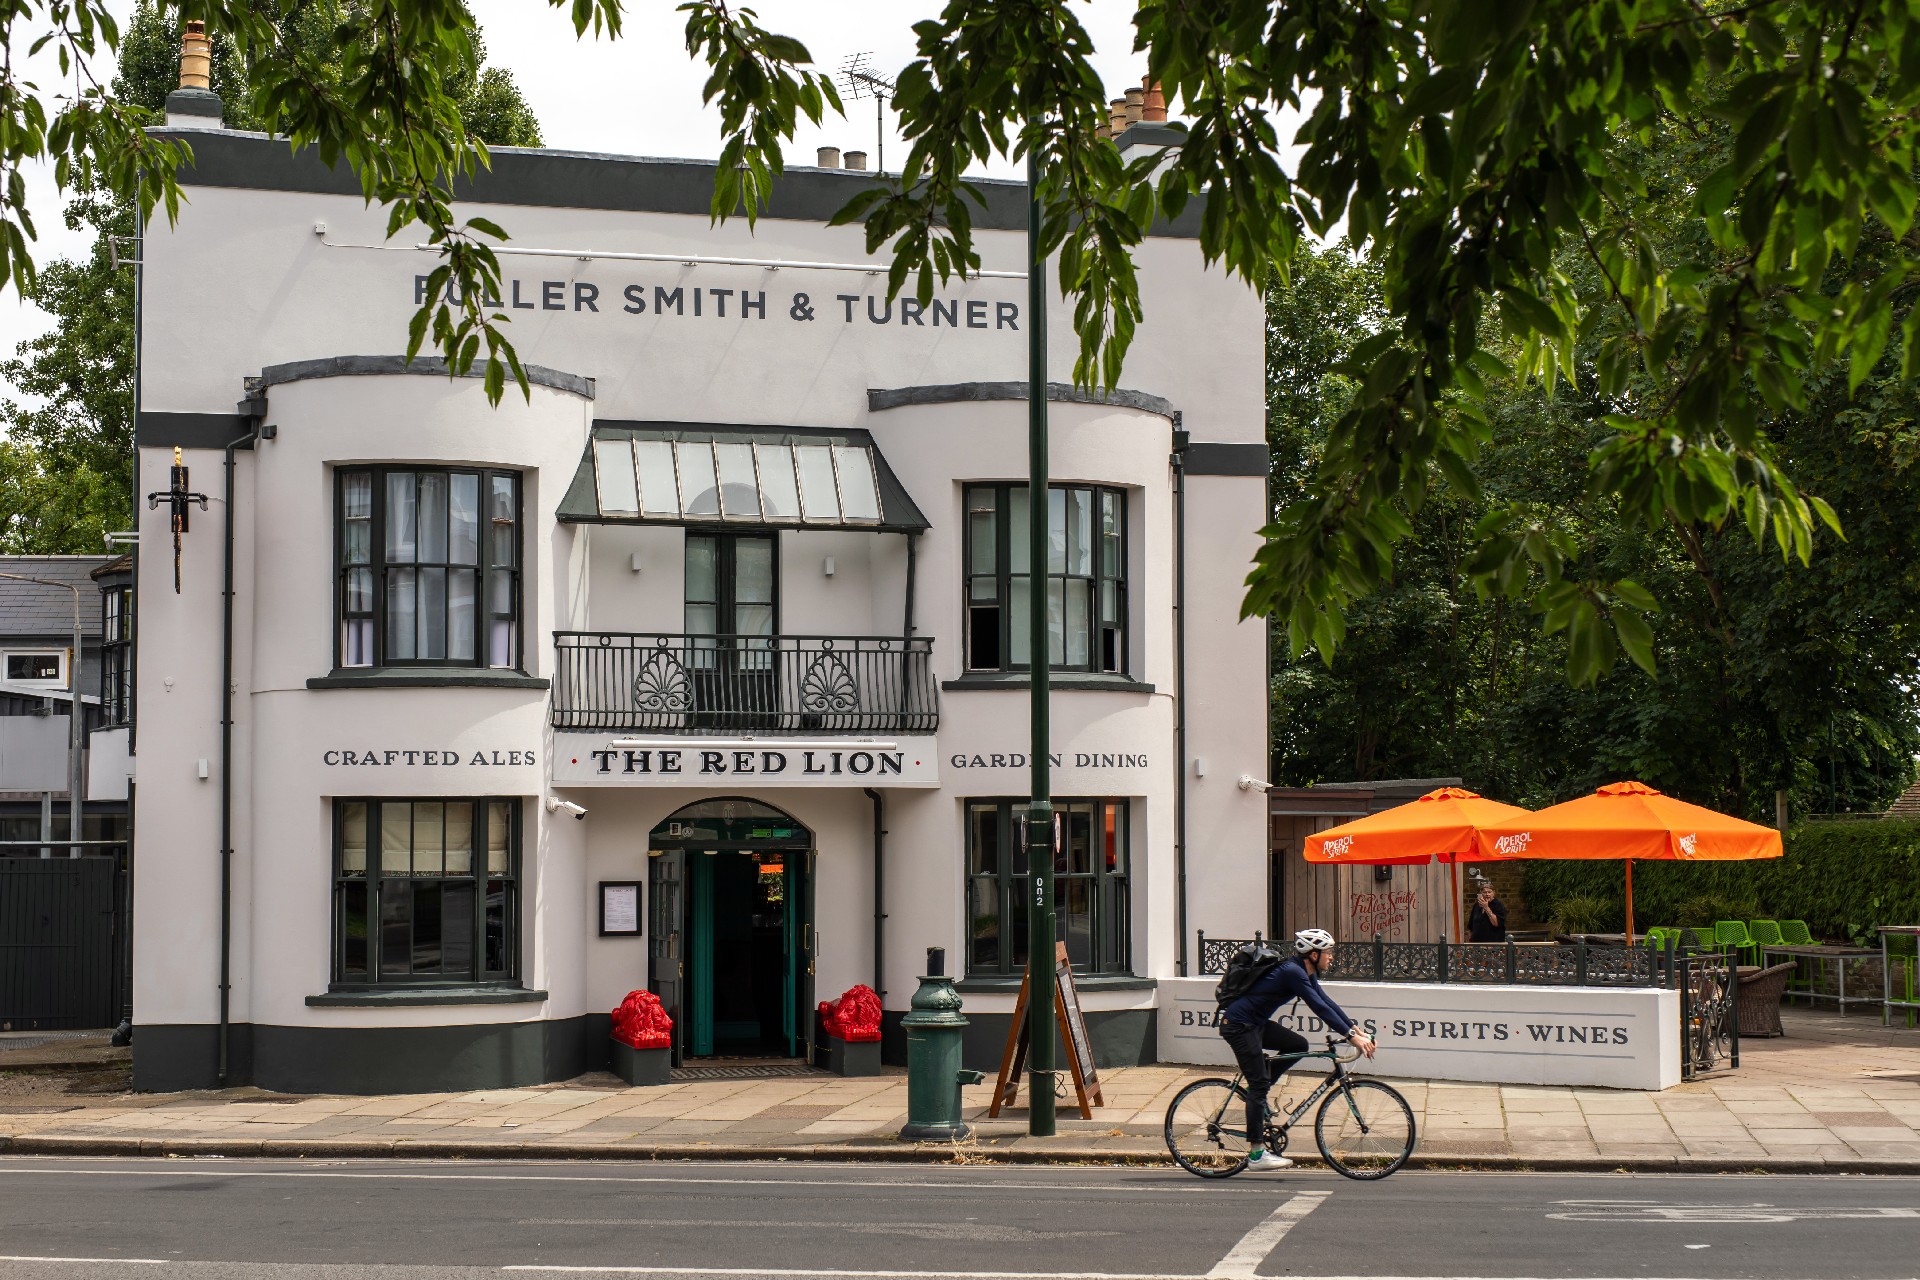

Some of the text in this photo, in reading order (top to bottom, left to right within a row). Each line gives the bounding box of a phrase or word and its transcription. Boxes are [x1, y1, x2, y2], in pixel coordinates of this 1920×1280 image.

[623, 284, 766, 320] SMITH
[790, 292, 815, 322] &
[837, 294, 1020, 331] TURNER
[323, 750, 536, 766] CRAFTED ALES
[591, 750, 905, 776] THE RED LION
[950, 753, 1148, 768] GARDN DINING
[1322, 835, 1354, 854] APEROL
[1494, 831, 1532, 849] APEROL
[1386, 891, 1417, 915] Smith
[1392, 1019, 1509, 1041] SPIRITS
[1526, 1024, 1629, 1045] WINES
